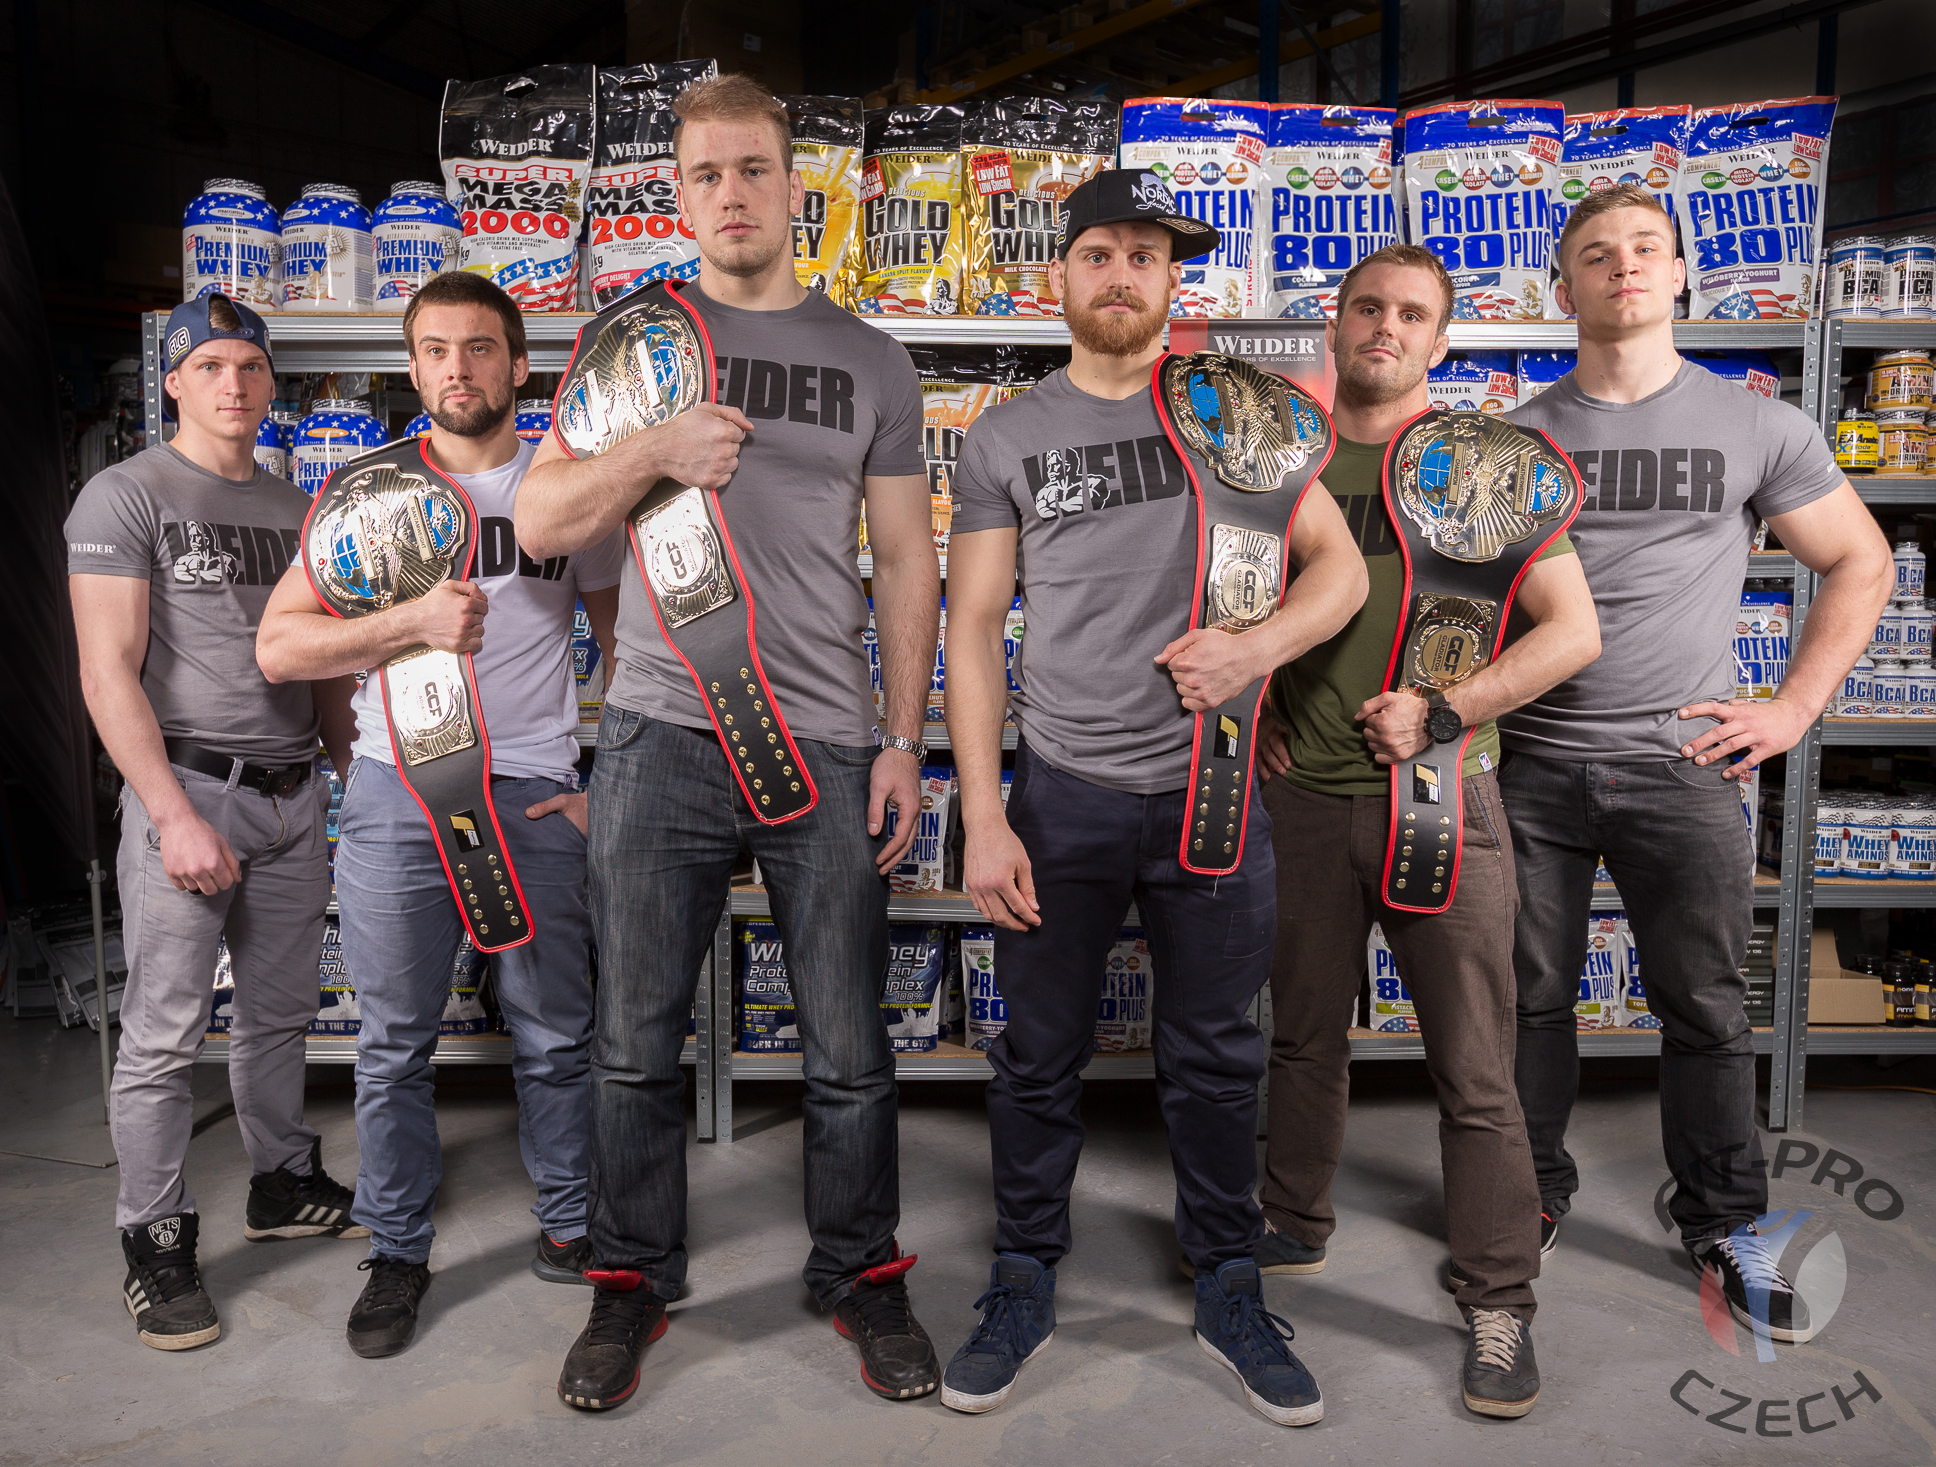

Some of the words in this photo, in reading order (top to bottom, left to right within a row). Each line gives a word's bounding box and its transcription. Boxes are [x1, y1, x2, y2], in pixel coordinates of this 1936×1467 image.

[480, 139, 552, 156] WEIDER
[1041, 144, 1074, 152] EXCELLENCE
[1458, 140, 1476, 148] YEARS
[1548, 139, 1560, 152] FAT
[1655, 144, 1670, 154] LOW
[1794, 144, 1805, 155] LOW
[1795, 135, 1810, 147] LOW
[1810, 138, 1822, 150] FAT
[885, 154, 932, 164] WEIDER
[1590, 159, 1634, 172] WEIDER
[1654, 152, 1666, 162] LOW
[456, 166, 570, 182] SUPER
[590, 166, 678, 187] SUPE
[976, 168, 994, 182] LOW
[995, 164, 1010, 178] FAT
[1201, 170, 1221, 178] WHEY
[1288, 174, 1310, 182] CASEIN
[1342, 174, 1364, 183] WHEY
[1436, 176, 1458, 184] CASEIN
[1492, 172, 1514, 182] WHEY
[1702, 176, 1726, 184] CASEIN
[1760, 168, 1784, 178] WHEY
[458, 178, 570, 198] MEGA
[590, 180, 677, 201] MEG
[888, 188, 926, 198] DELICIOUS
[979, 182, 992, 194] LOW
[992, 178, 1012, 192] SUGAR
[1018, 189, 1056, 199] DELICIOUS
[1562, 185, 1586, 193] CASEIN
[462, 194, 566, 214] MASS
[592, 198, 680, 216] MAS
[990, 190, 1064, 231] GOL
[1174, 189, 1256, 229] OTEIN
[1272, 187, 1396, 233] PROTEIN
[1420, 188, 1552, 236] PROTEIN
[1687, 183, 1819, 238] PROTEIN
[864, 192, 952, 238] GOLD
[461, 210, 570, 239] 2000
[195, 236, 270, 264] PREMIUM
[376, 236, 444, 258] PREMIUM
[864, 232, 950, 274] WHEY
[1272, 234, 1352, 272] 80
[1424, 233, 1505, 272] 80
[1508, 230, 1550, 272] PLUS
[1694, 226, 1783, 271] 80
[196, 258, 271, 279] WHEY
[282, 258, 328, 279] HEY
[376, 256, 444, 276] WHEY
[168, 330, 188, 358] GLG
[1214, 336, 1316, 355] WEIDER
[1491, 373, 1506, 383] LOW
[1749, 372, 1764, 384] LOW
[1764, 376, 1776, 388] FAT
[1428, 386, 1471, 394] WEIDER
[1488, 384, 1500, 392] LOW
[1021, 434, 1190, 523] WEID
[1452, 458, 1460, 486] CHAMPION
[1566, 448, 1726, 512] EIDER
[1516, 462, 1526, 503] FEATHERWEIGHT
[70, 543, 114, 554] WEIDER
[666, 542, 688, 580] GCF
[1243, 570, 1256, 614] GCF
[1434, 635, 1448, 672] GLADIATOR
[1444, 636, 1464, 676] GCF
[1734, 636, 1789, 660] OTEIN
[425, 682, 442, 718] GCF
[1848, 834, 1890, 850] WHEY
[1815, 848, 1842, 858] MINOS
[1847, 850, 1889, 860] AMINOS
[886, 978, 924, 994] plex
[896, 992, 924, 1001] 100%
[970, 998, 1010, 1022] 80
[1120, 999, 1146, 1020] PLUS
[315, 1022, 326, 1030] IN
[328, 1022, 346, 1030] THE
[894, 1039, 910, 1048] THE
[151, 1220, 178, 1236] NETS
